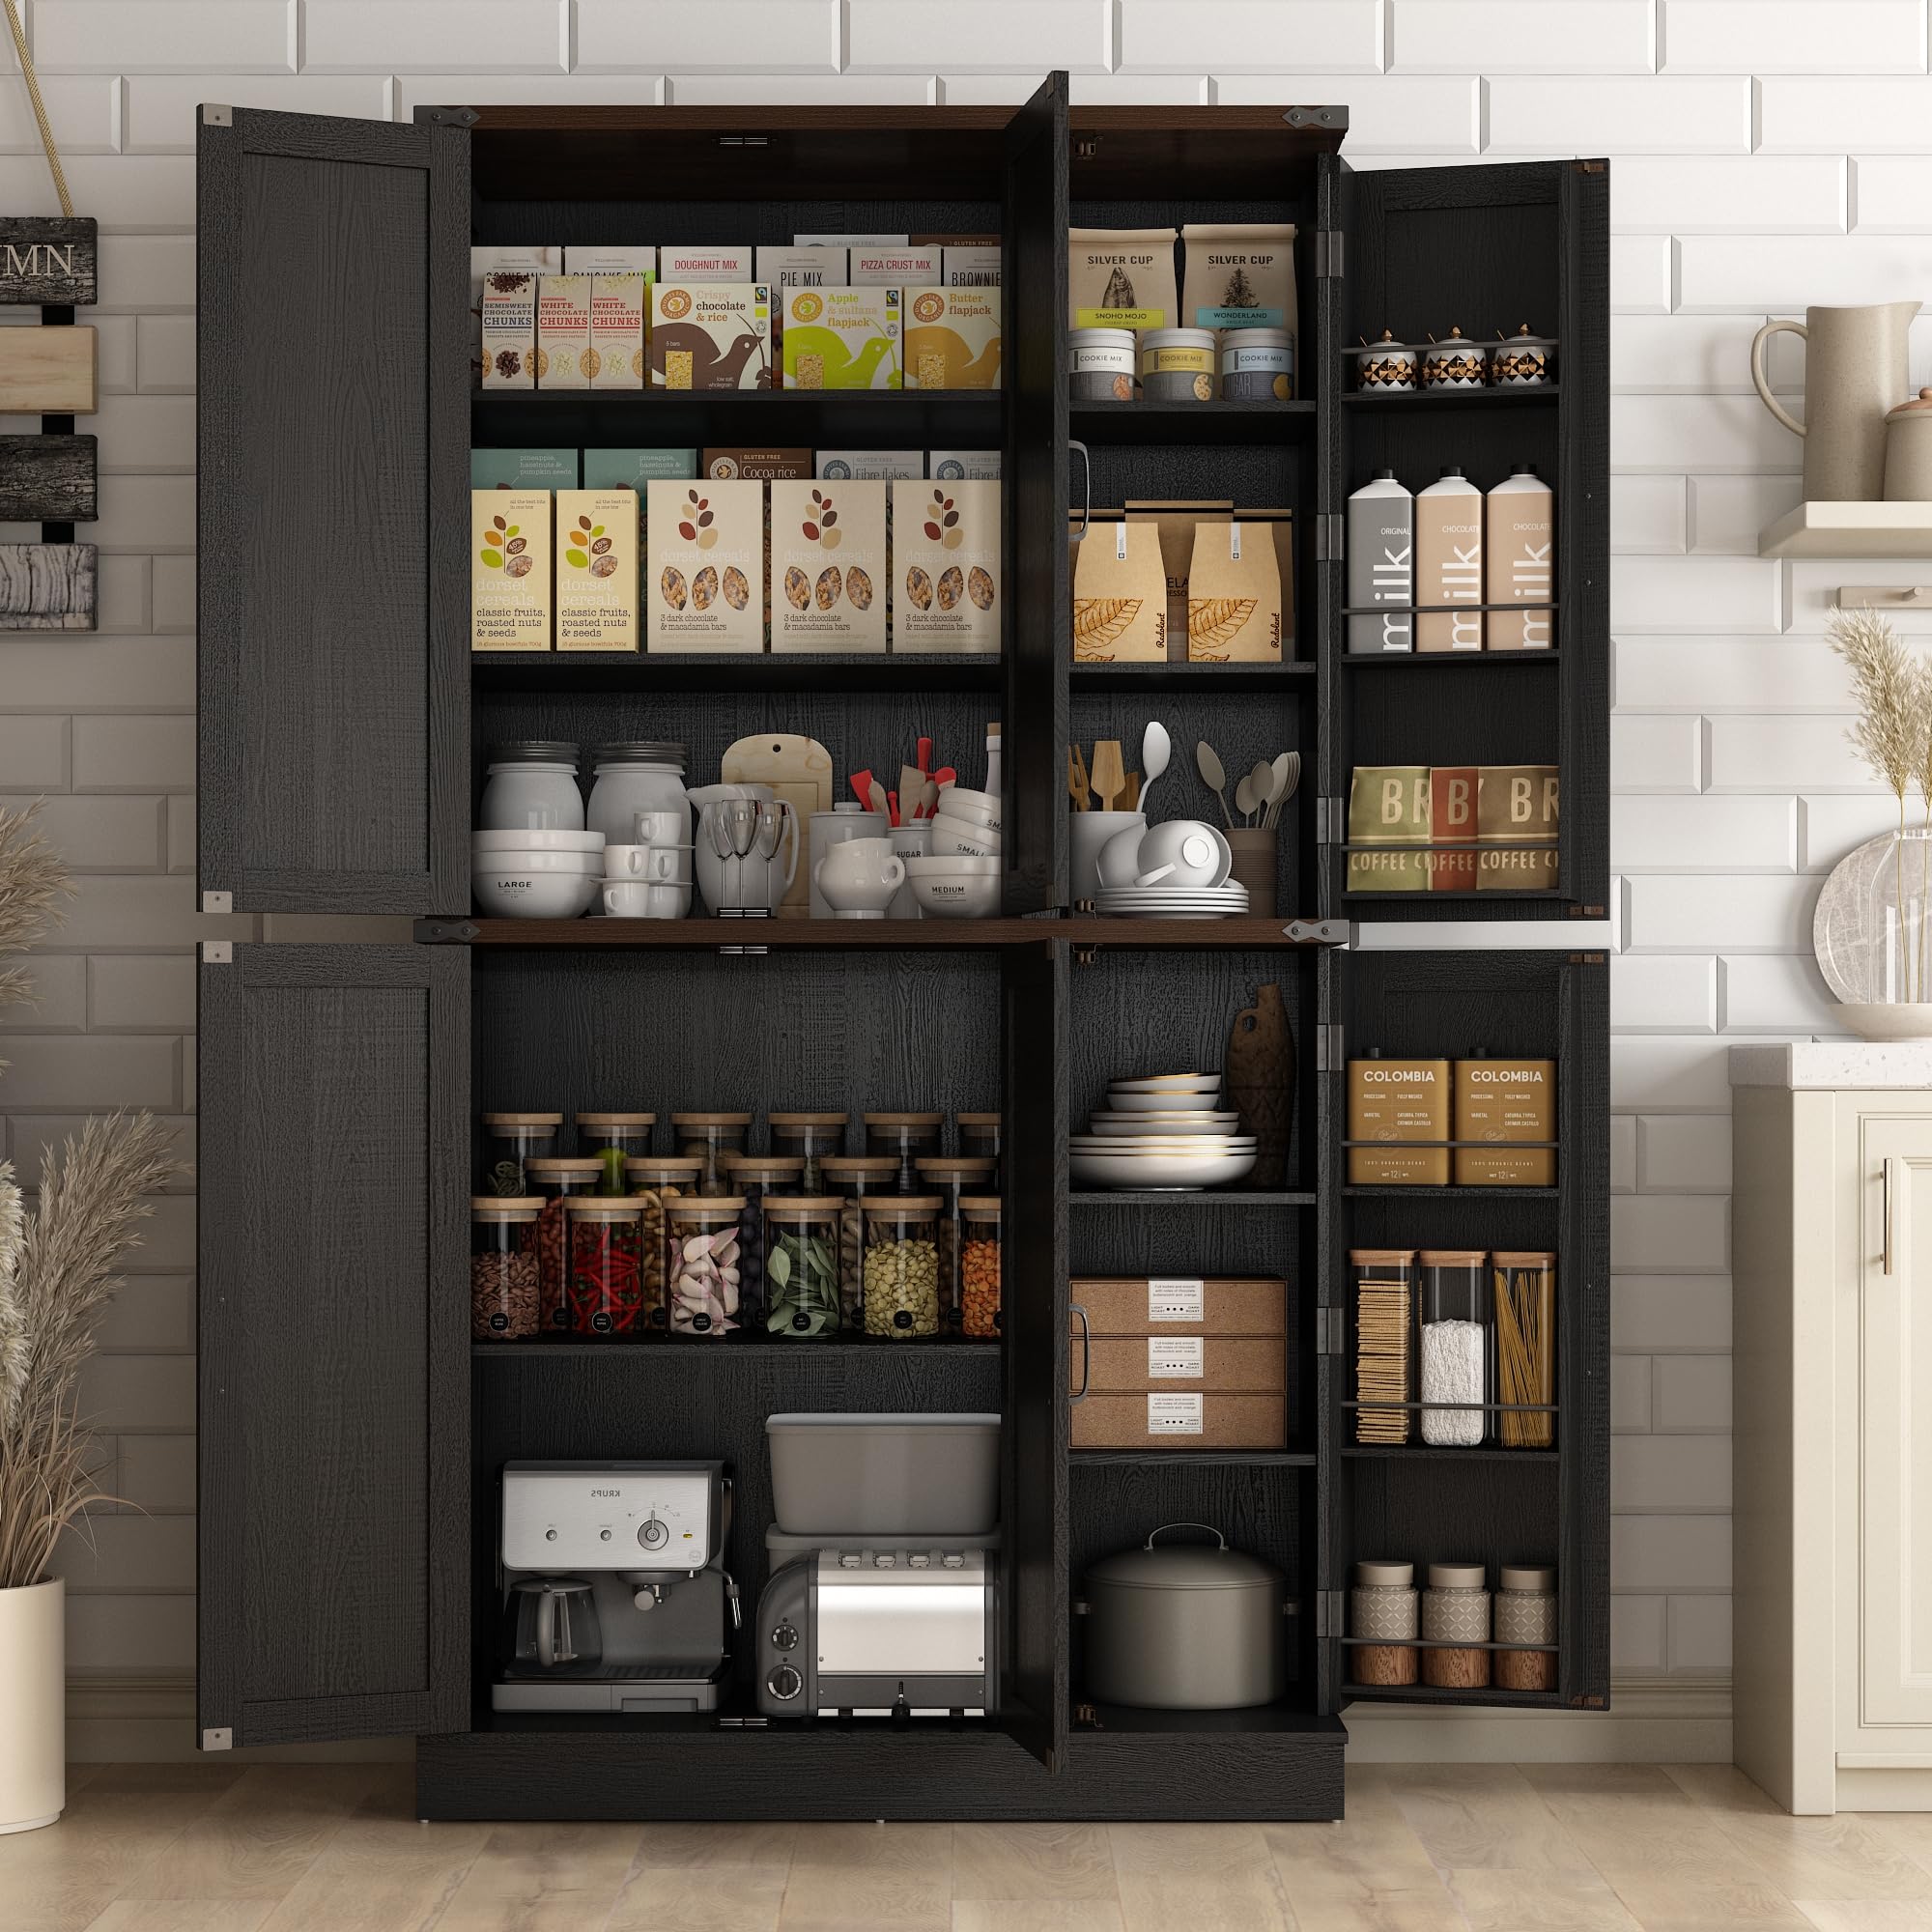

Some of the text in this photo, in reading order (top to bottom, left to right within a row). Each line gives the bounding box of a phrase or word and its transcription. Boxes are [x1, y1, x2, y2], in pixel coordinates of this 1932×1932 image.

[0, 244, 75, 276] MN
[675, 260, 738, 270] DOUGHNUT MIX
[861, 260, 931, 270] PIZZA CRUST MIX
[1088, 256, 1153, 264] SILVER CUP
[1208, 256, 1273, 264] SILVER CUP
[781, 272, 823, 286] PIE MIX
[952, 272, 1001, 286] BROWNIE
[696, 290, 731, 301] Crispy
[827, 294, 858, 304] Apple
[949, 294, 983, 303] Butter
[696, 301, 746, 310] chocolate
[696, 313, 728, 321] & rice
[949, 306, 991, 317] flapjack
[484, 317, 532, 325] CHUNKS
[540, 317, 588, 325] CHUNKS
[592, 317, 640, 325] CHUNKS
[828, 318, 870, 328] flapjack
[742, 466, 796, 479] Cocoa rice
[856, 467, 909, 481] Fibre flakes
[969, 467, 993, 479] Fibre
[1373, 545, 1411, 650] milk
[1441, 544, 1480, 649] milk
[1512, 541, 1551, 647] milk
[476, 608, 546, 618] classic fruits,
[561, 608, 631, 618] classic fruits,
[476, 629, 516, 637] & seeds
[561, 629, 601, 637] & seeds
[1156, 612, 1166, 648] Redolent
[1270, 612, 1280, 649] Redolent
[1448, 779, 1469, 825] B
[1351, 853, 1406, 871] COFFEE
[1431, 853, 1473, 872] OFFEE
[1480, 851, 1536, 870] COFFEE
[1364, 1071, 1435, 1082] COLOMBIA
[1471, 1071, 1543, 1083] COLOMBIA
